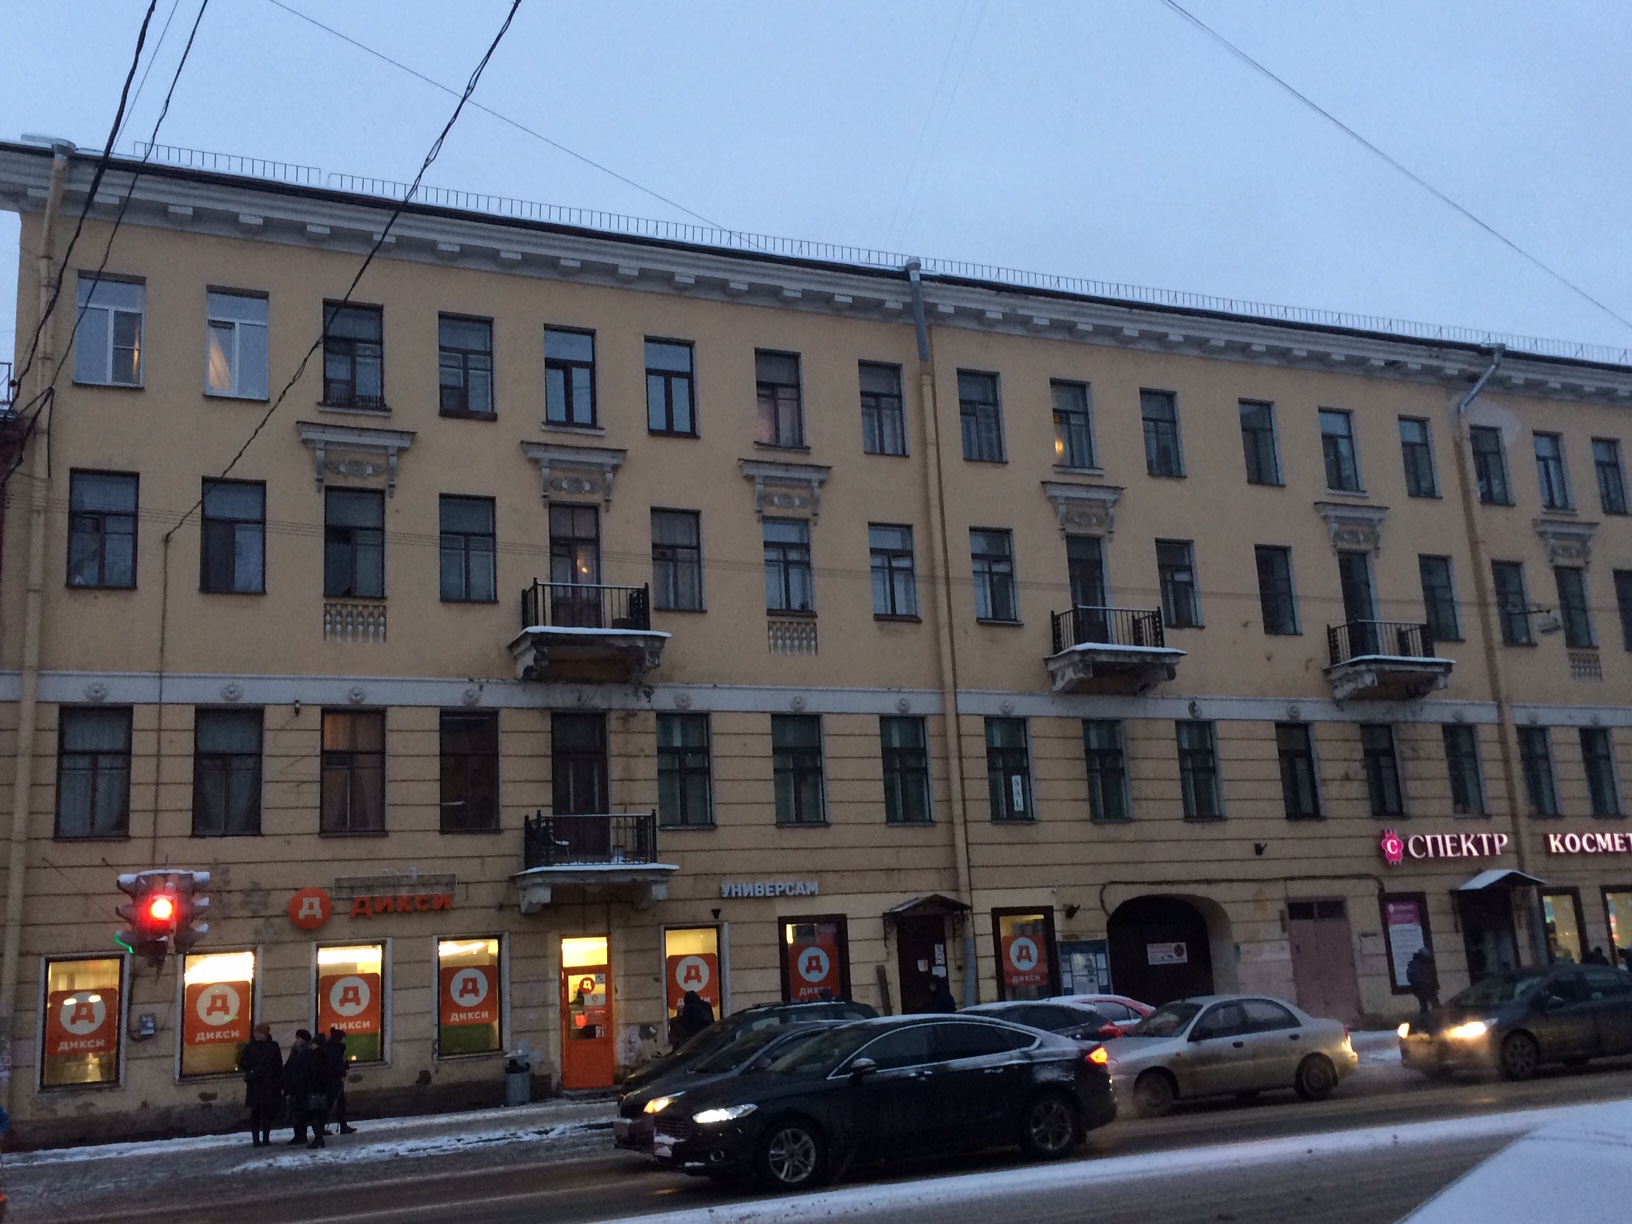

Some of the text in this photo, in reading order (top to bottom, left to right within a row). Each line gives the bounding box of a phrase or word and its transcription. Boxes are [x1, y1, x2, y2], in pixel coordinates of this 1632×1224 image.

[1408, 832, 1508, 859] СПЕКТР
[721, 881, 820, 898] УНИВЕРСАМ
[298, 893, 452, 920] Д ДИКСИ
[1016, 945, 1033, 963] Д
[683, 964, 702, 984] Д
[805, 955, 823, 974] Д
[459, 977, 480, 998] Д
[1011, 974, 1041, 984] ДИКСИ
[339, 986, 361, 1008] Д
[799, 985, 831, 997] ДИК
[69, 1002, 95, 1026] Д
[206, 993, 230, 1017] Д
[450, 1009, 489, 1023] ДИКСИ
[195, 1028, 240, 1042] ДИКСИ
[58, 1040, 105, 1052] ДИКСИ
